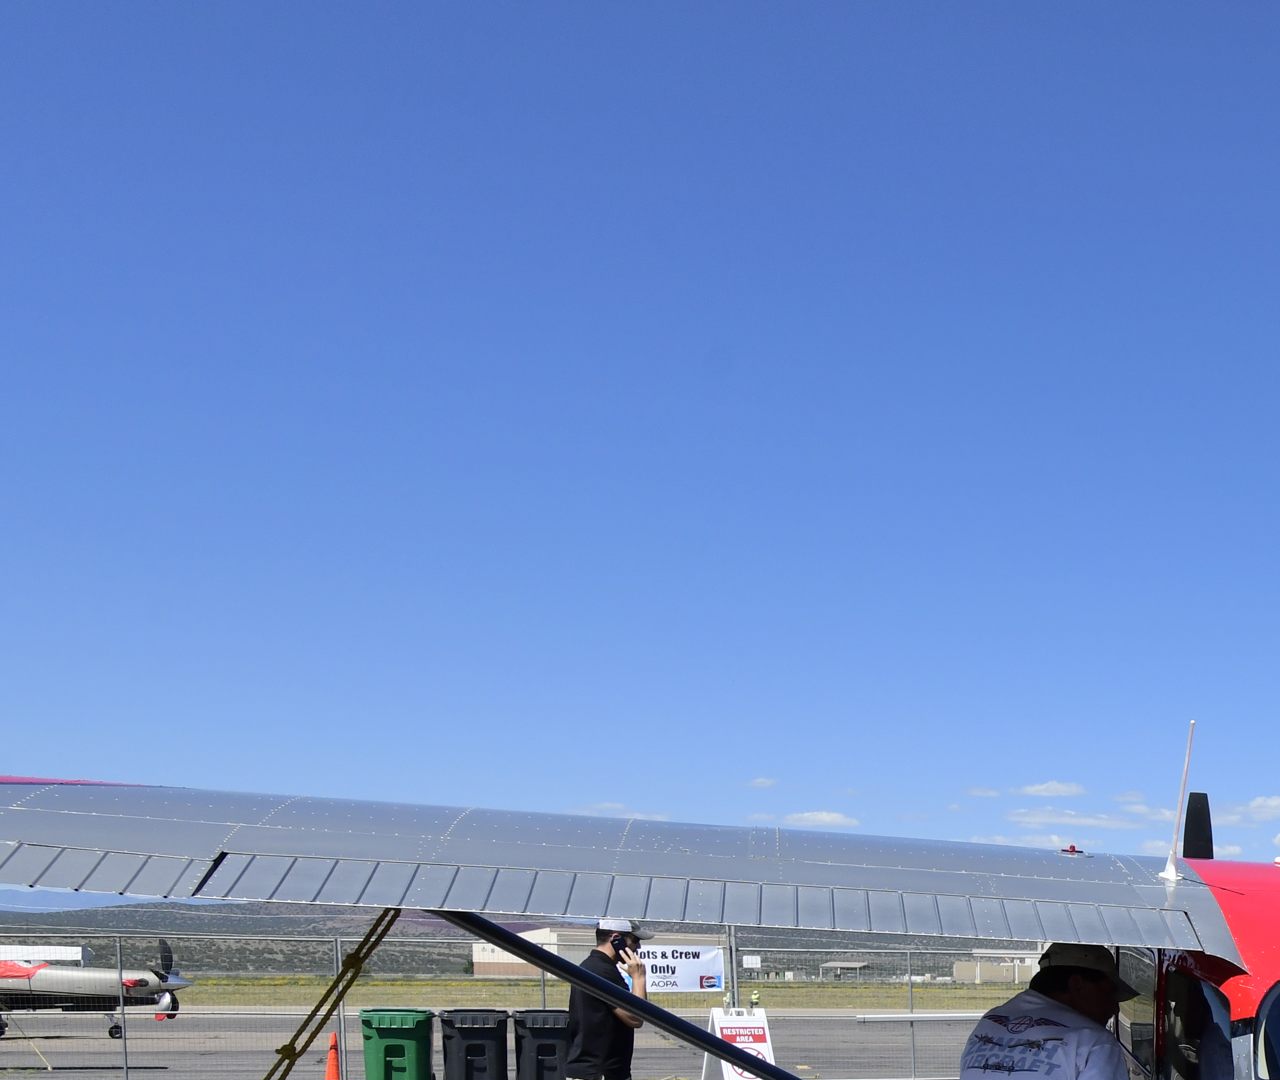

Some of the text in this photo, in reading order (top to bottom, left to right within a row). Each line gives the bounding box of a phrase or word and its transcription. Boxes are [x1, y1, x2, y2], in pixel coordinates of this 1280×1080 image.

[660, 949, 669, 960] &
[671, 949, 701, 960] Crew
[650, 964, 677, 976] Only
[650, 980, 679, 988] AOPA
[735, 1035, 754, 1043] AREA
